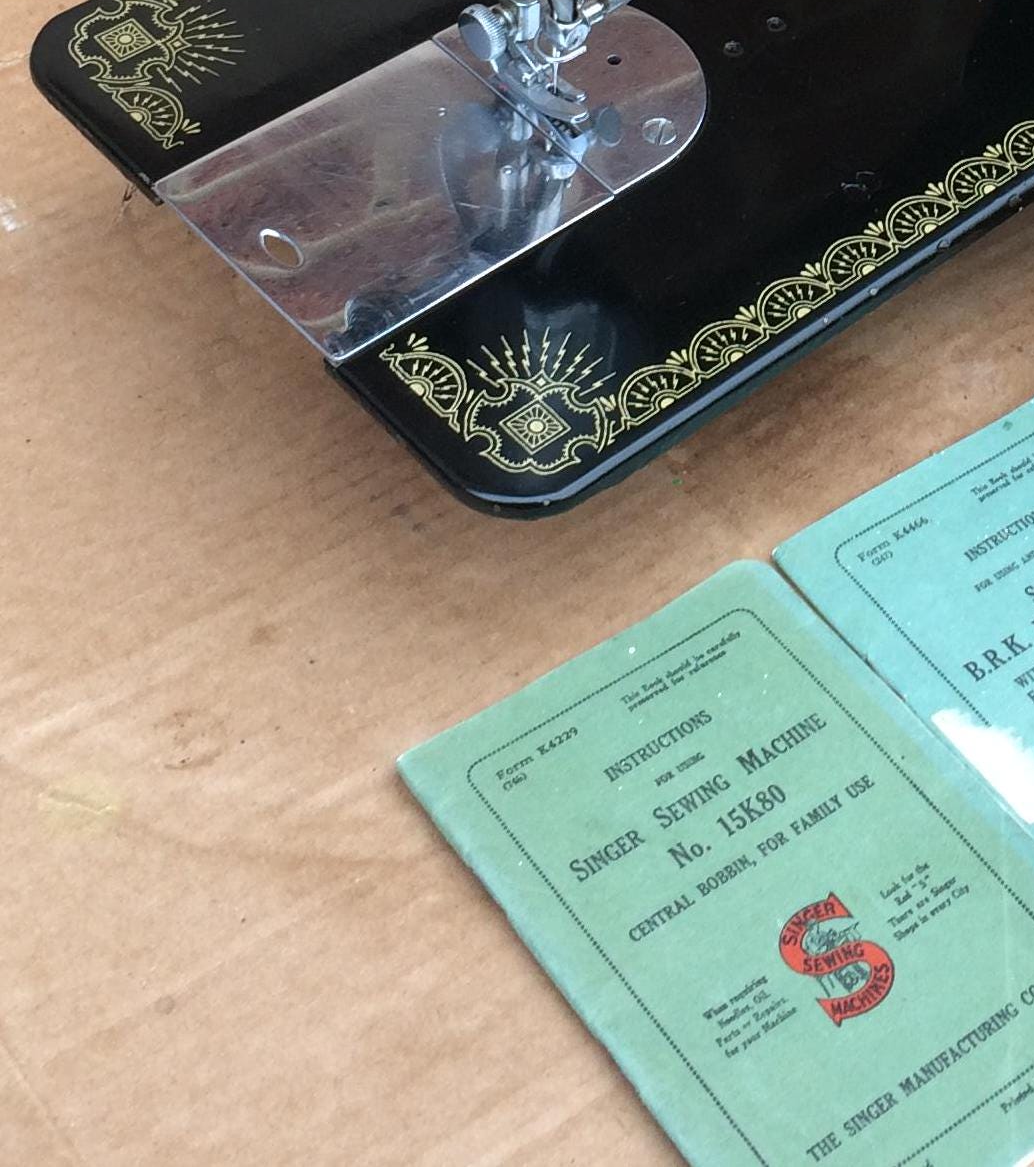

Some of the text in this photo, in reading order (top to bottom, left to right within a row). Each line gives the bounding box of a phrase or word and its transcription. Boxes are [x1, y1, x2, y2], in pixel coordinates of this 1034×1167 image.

[856, 540, 891, 564] Form
[974, 577, 995, 594] FOR
[706, 630, 742, 657] carefully
[963, 633, 1034, 682] B.R.K.
[495, 726, 579, 781] Form K4229
[602, 709, 713, 783] INSTRUCTIONS
[654, 751, 706, 787] FOR USING
[569, 712, 828, 883] SINGER SEWING MACHINE
[666, 783, 787, 870] No. 15K80
[628, 774, 876, 943] CENTRAL BOBBIN, FOR FAMILY USE
[879, 861, 931, 900] Look for the
[782, 900, 836, 946] SINGER
[887, 876, 957, 929] There are Singer
[893, 884, 971, 942] Shops in every City
[802, 942, 865, 973] SEWING
[702, 975, 769, 1021] When requiring
[830, 962, 891, 1017] MACHINES
[715, 1028, 741, 1048] Parts
[741, 1020, 752, 1031] or
[724, 1006, 798, 1059] for your Machine
[805, 1131, 842, 1164] THE
[843, 1091, 899, 1138] SINGER
[898, 1001, 1020, 1098] MANUFACTURING
